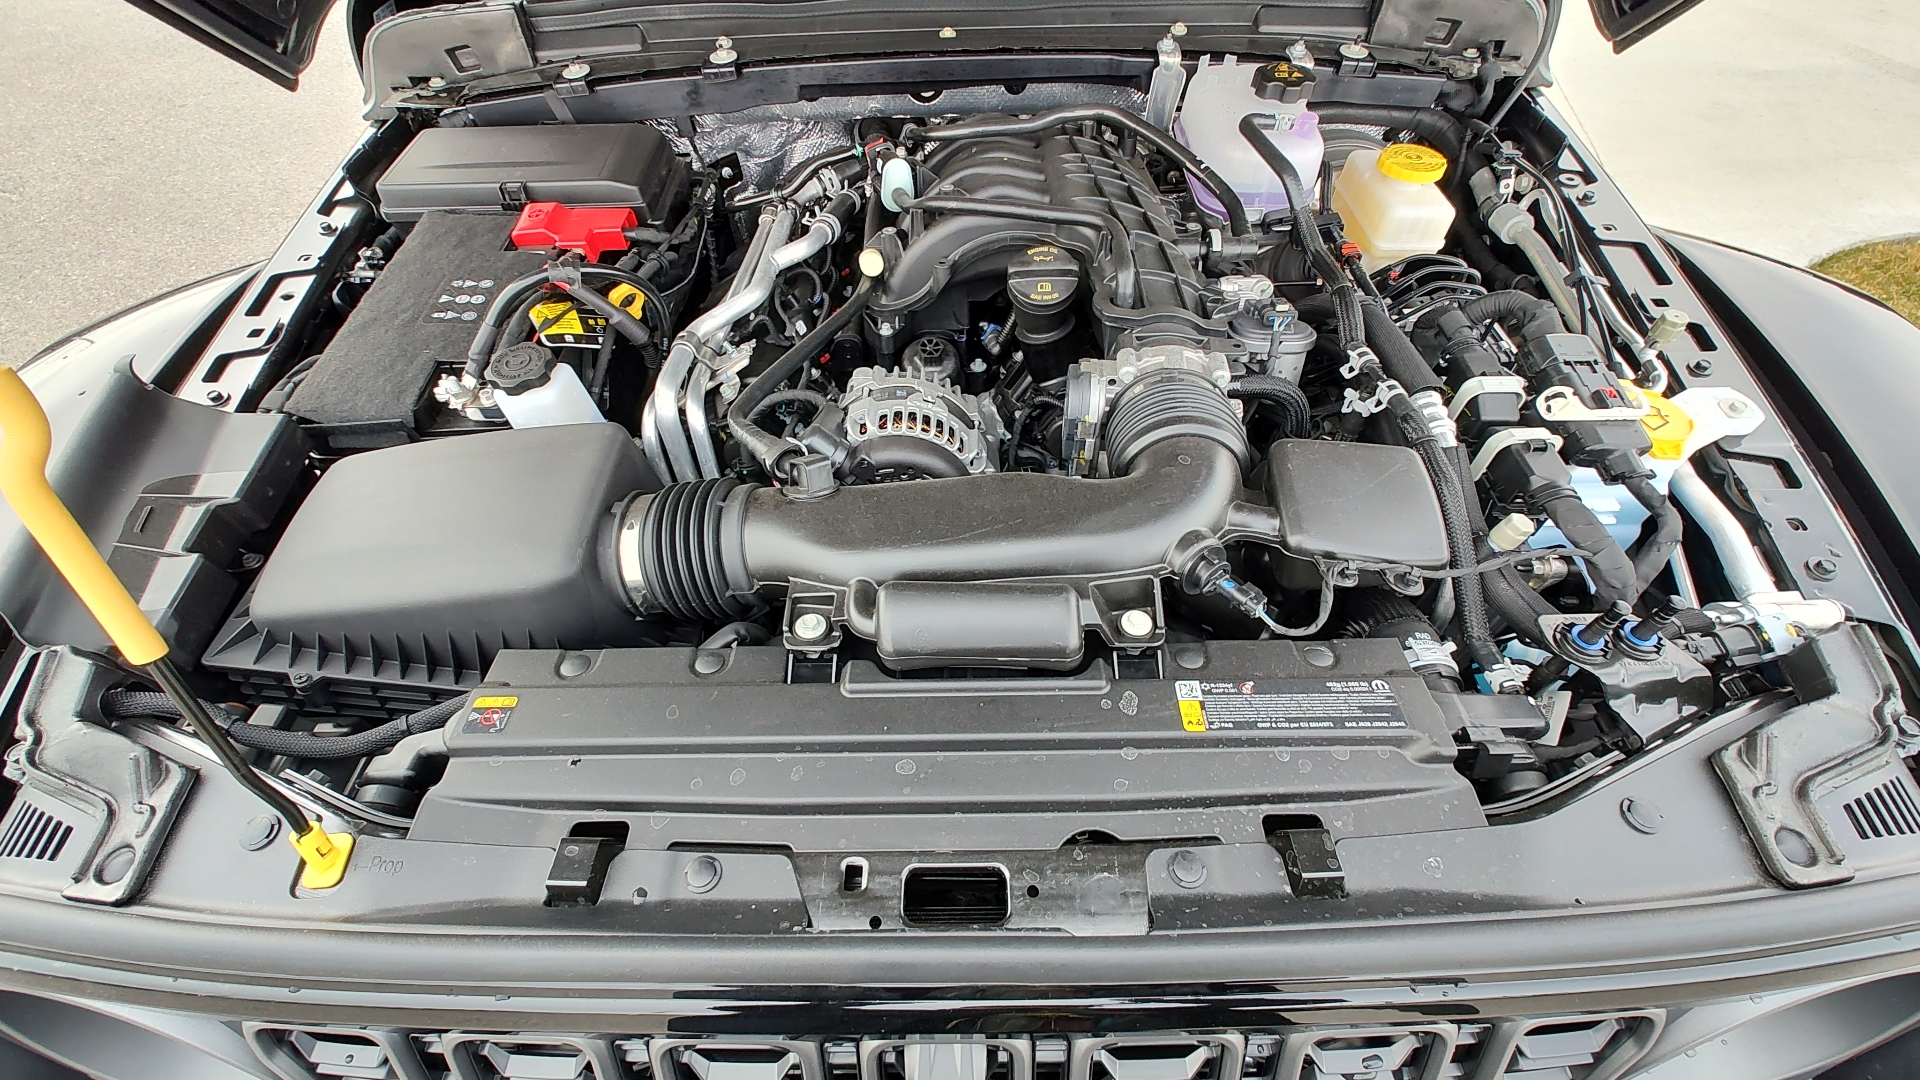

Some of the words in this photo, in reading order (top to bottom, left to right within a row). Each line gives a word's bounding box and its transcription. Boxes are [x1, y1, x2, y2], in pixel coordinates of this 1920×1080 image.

[1027, 247, 1048, 255] ENGINE
[1415, 632, 1431, 640] RAD
[368, 855, 404, 877] Prop
